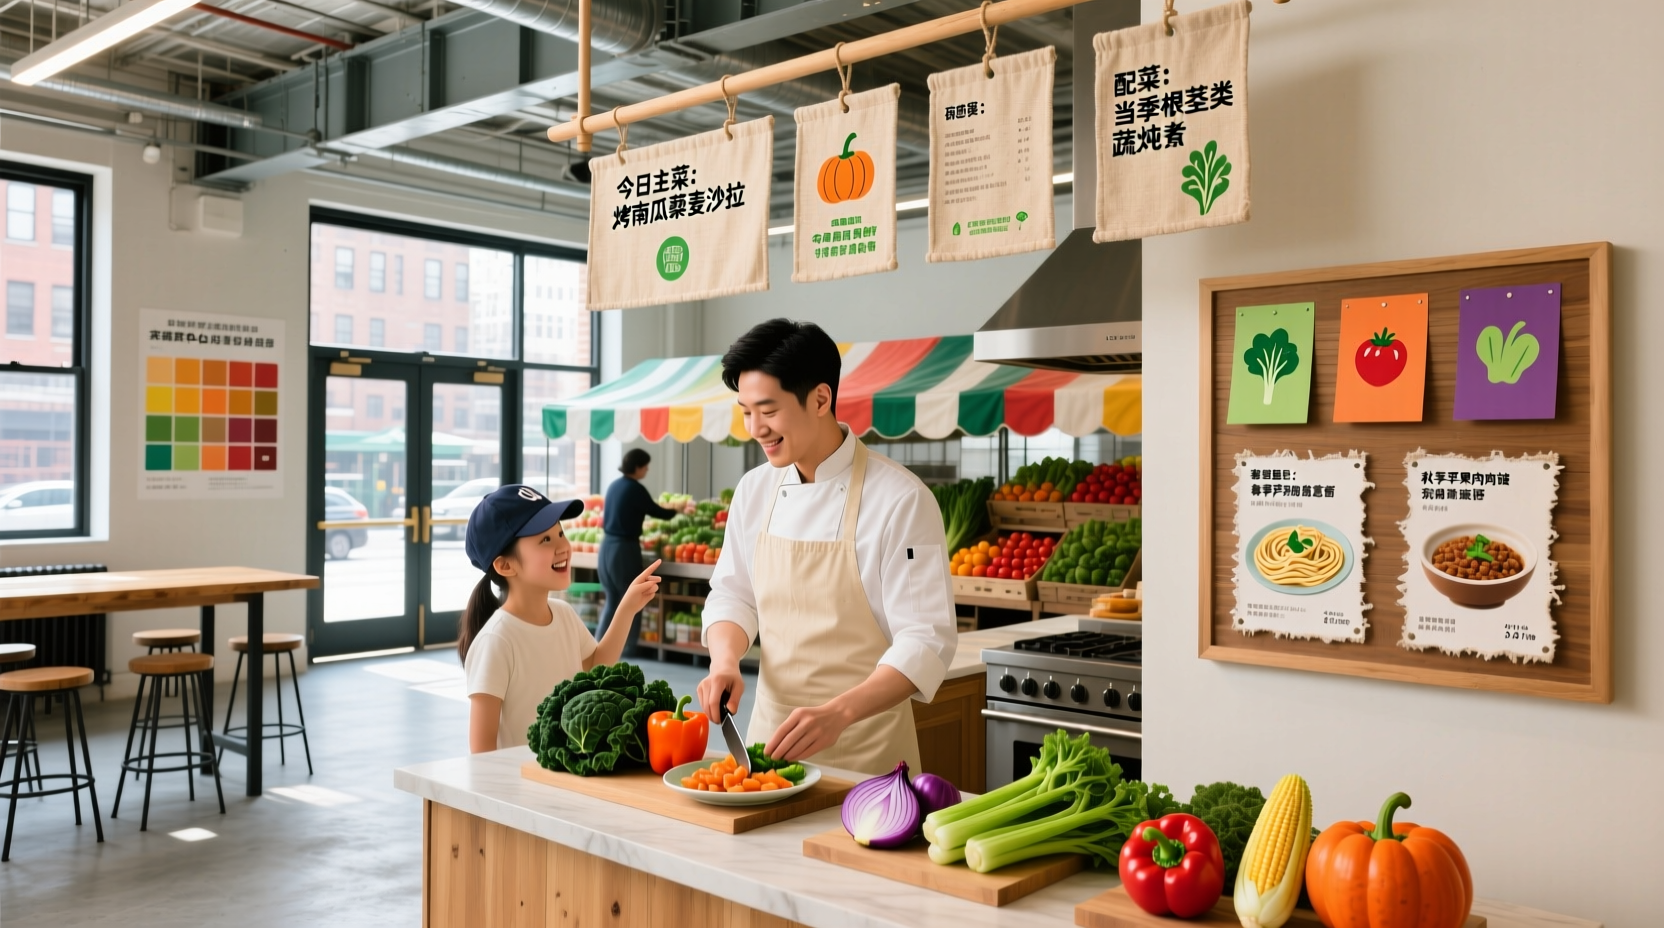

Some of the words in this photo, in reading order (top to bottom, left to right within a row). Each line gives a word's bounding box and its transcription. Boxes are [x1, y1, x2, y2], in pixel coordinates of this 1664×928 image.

[1114, 80, 1234, 126] 当季根茎类
[1112, 121, 1186, 157] 蔬炖煮
